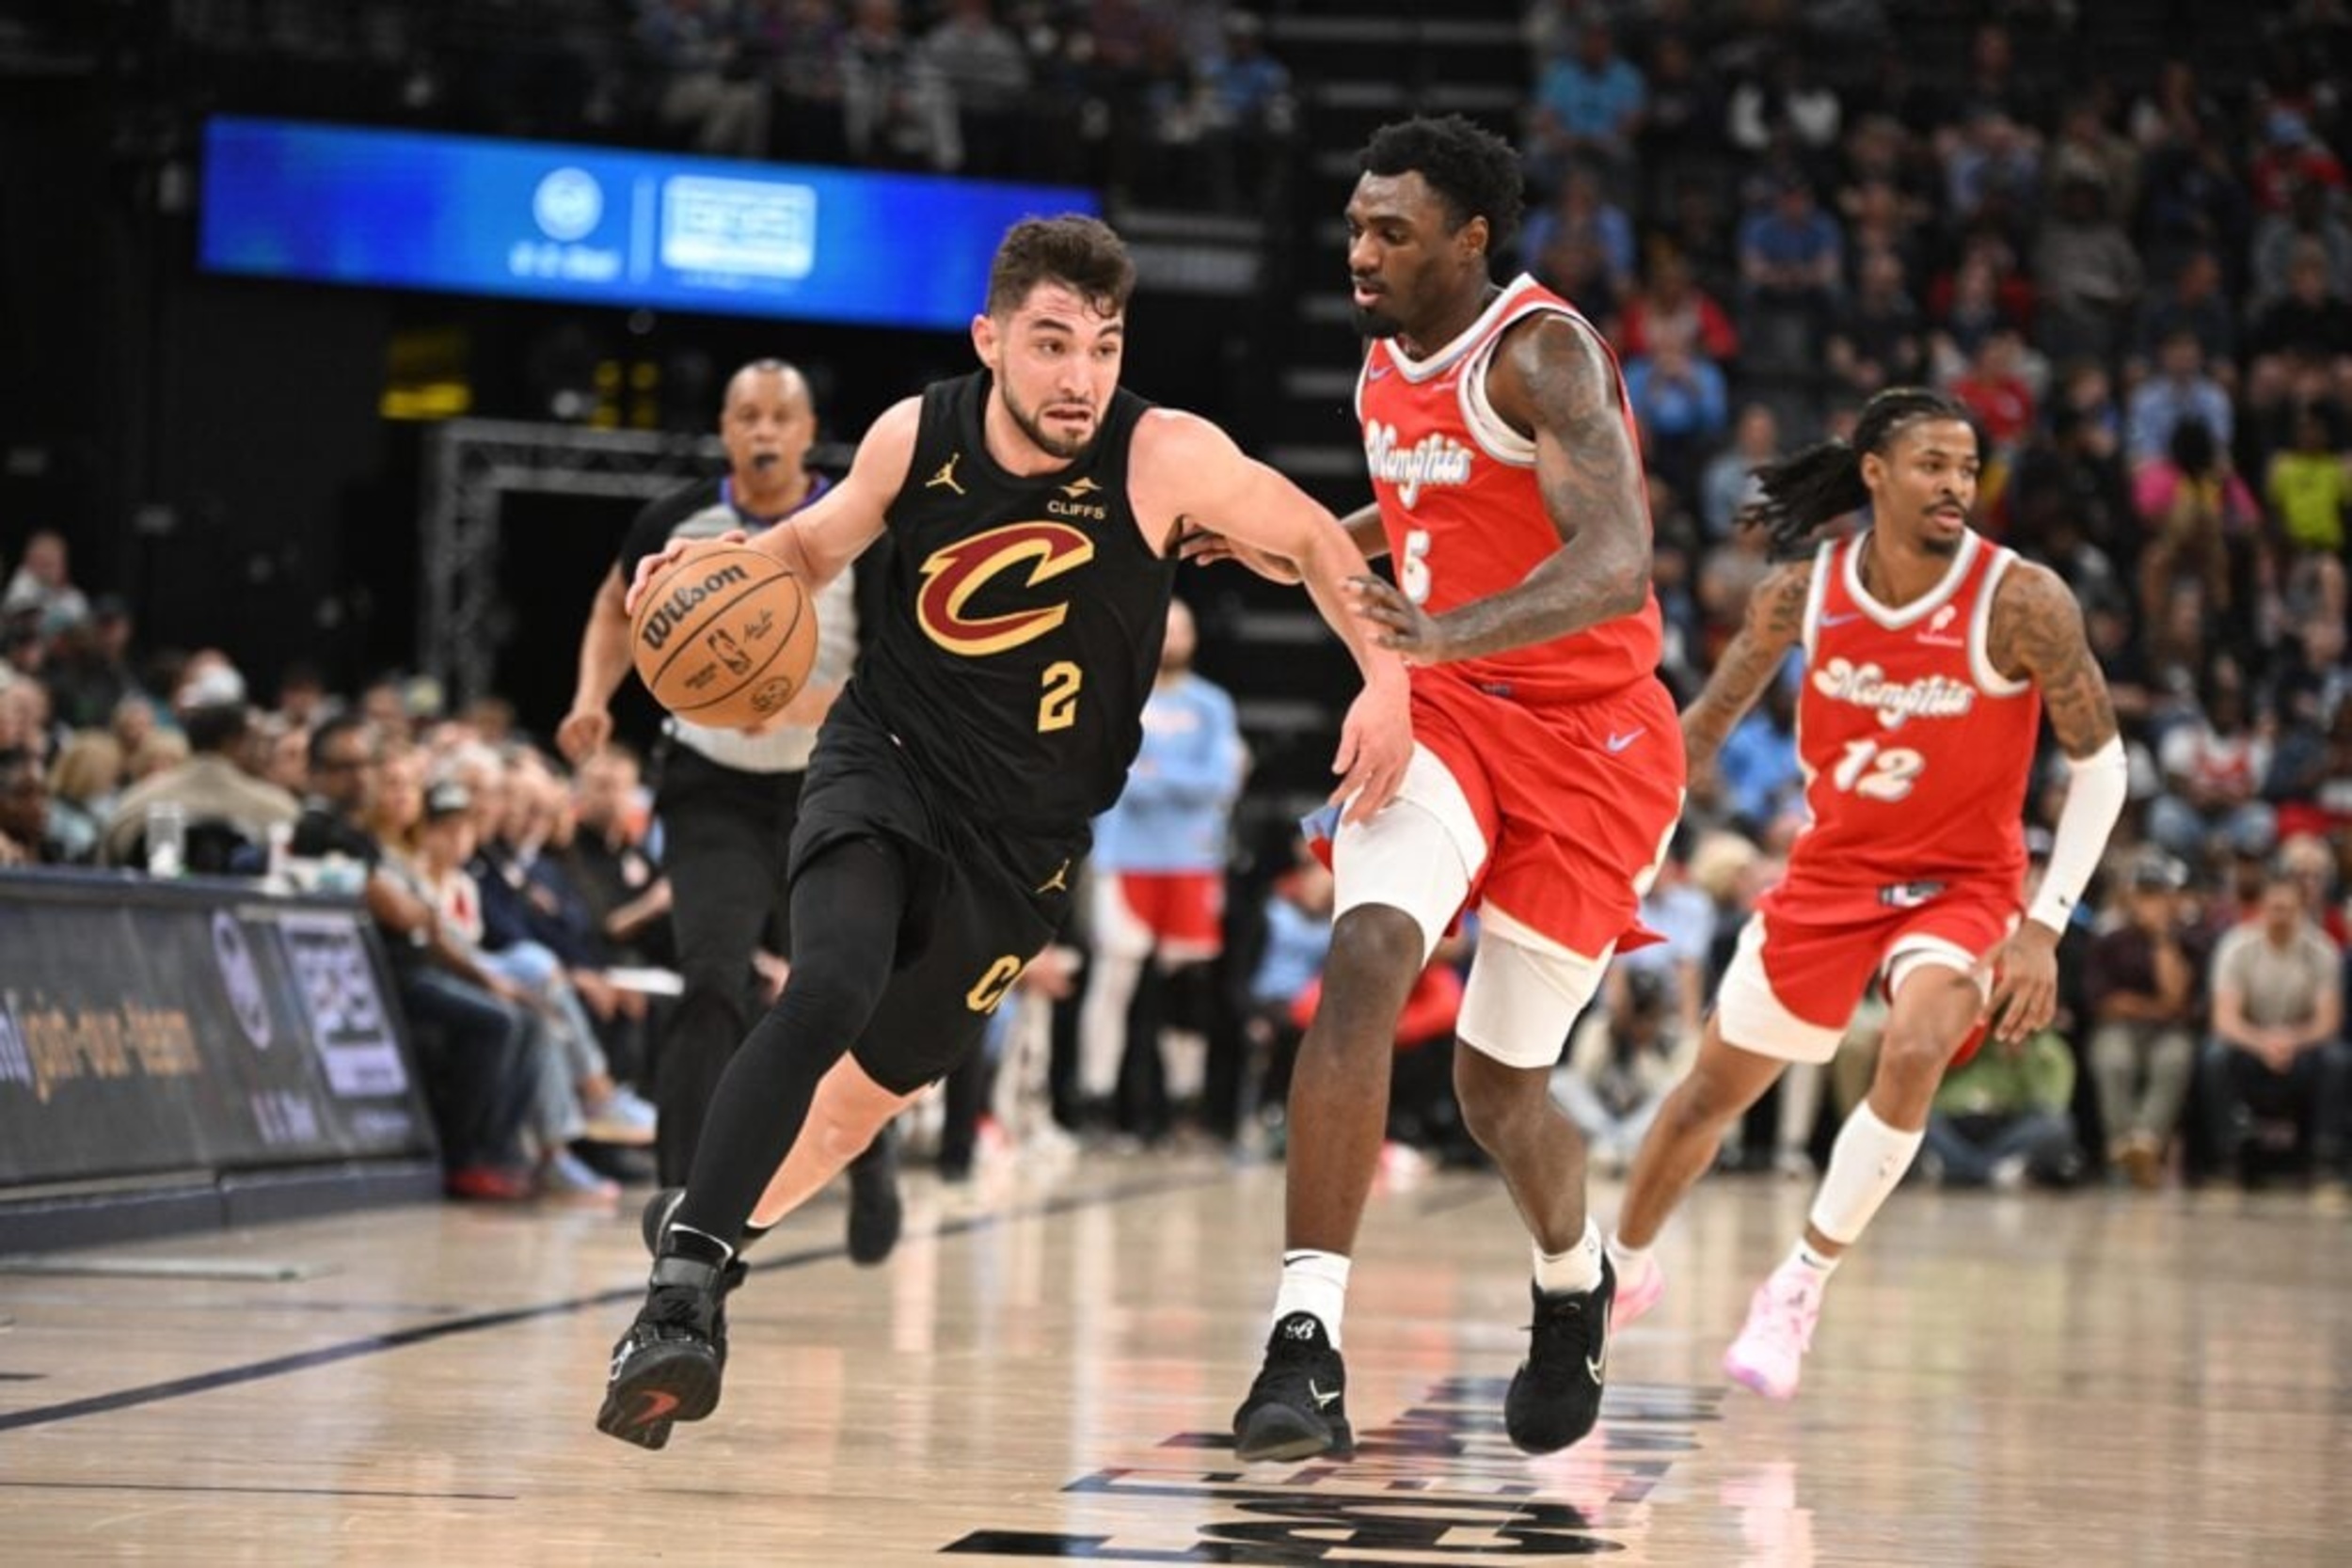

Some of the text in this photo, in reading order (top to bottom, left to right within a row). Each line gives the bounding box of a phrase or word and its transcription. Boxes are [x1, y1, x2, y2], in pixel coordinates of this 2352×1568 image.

[1046, 499, 1105, 520] CLIFFS
[642, 564, 749, 650] Wilson
[1038, 660, 1081, 733] 2
[1812, 656, 1977, 729] Memphis
[1834, 739, 1925, 802] 12
